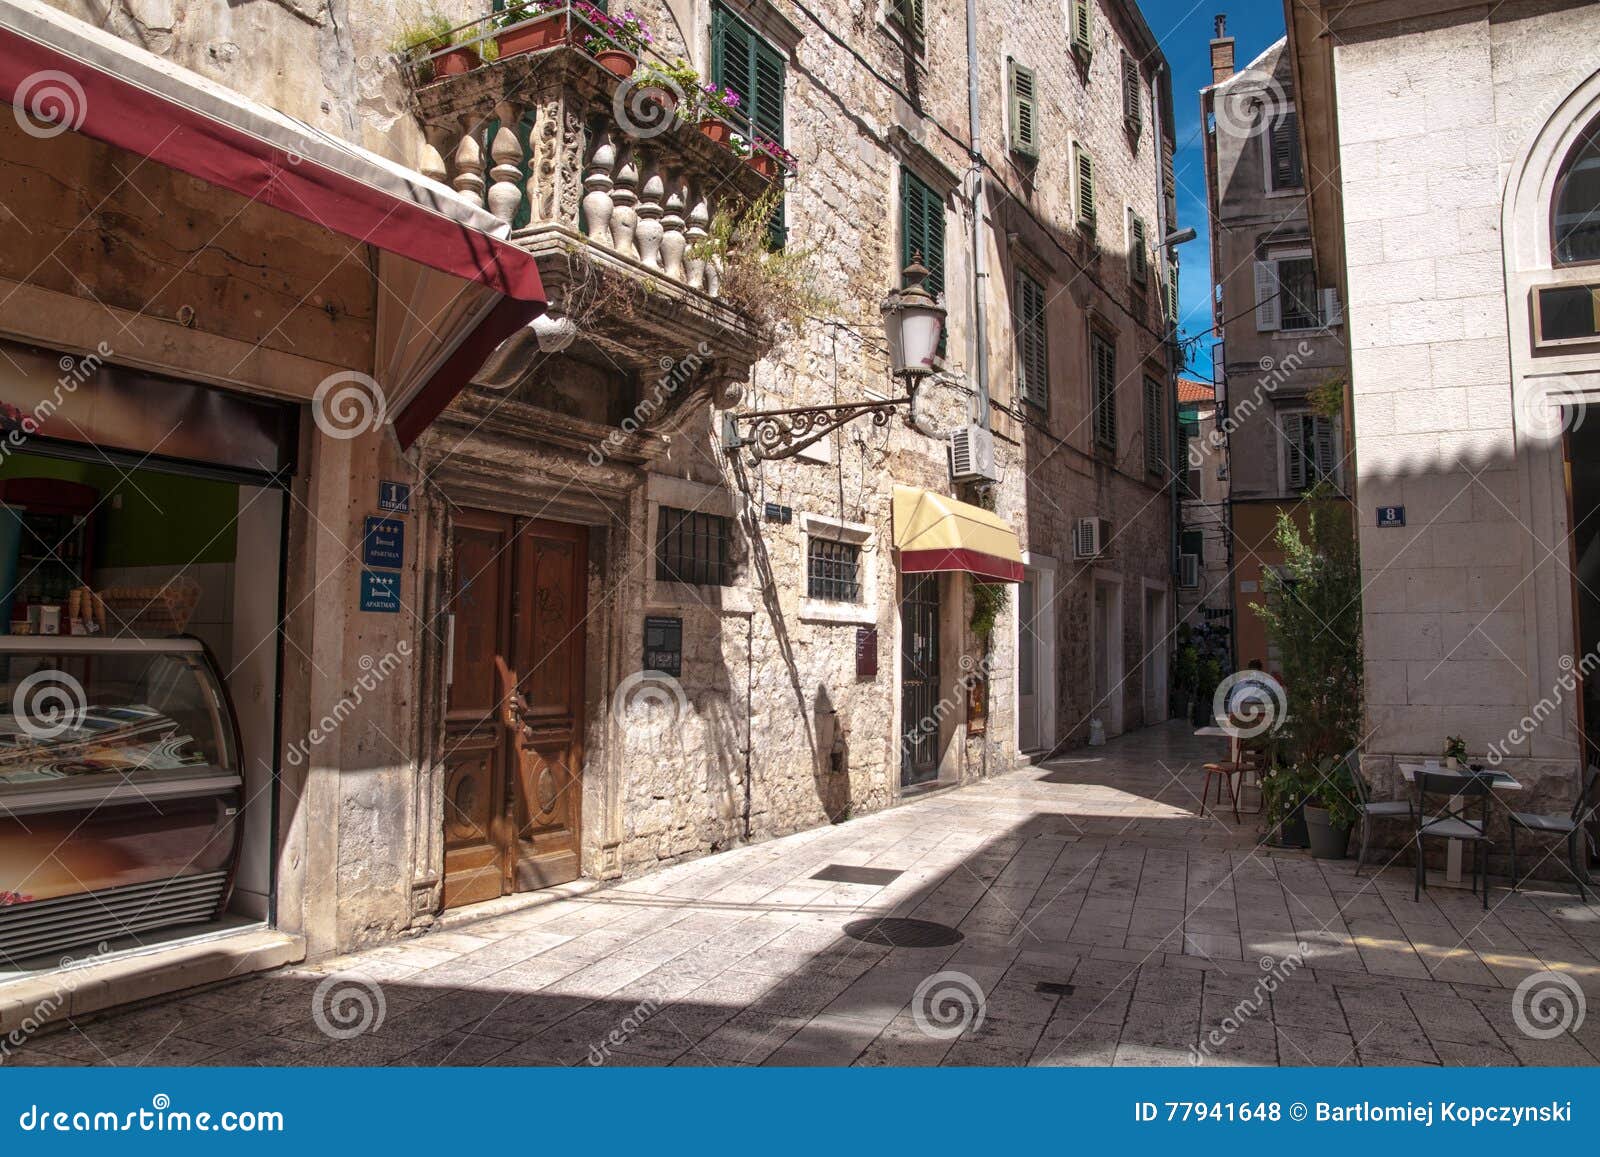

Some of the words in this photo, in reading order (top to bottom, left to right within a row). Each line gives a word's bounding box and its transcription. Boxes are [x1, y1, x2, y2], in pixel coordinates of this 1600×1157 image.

[390, 486, 397, 501] 1
[1386, 508, 1396, 520] 8
[370, 550, 399, 559] APARTMAN
[365, 601, 395, 609] APARTMAN
